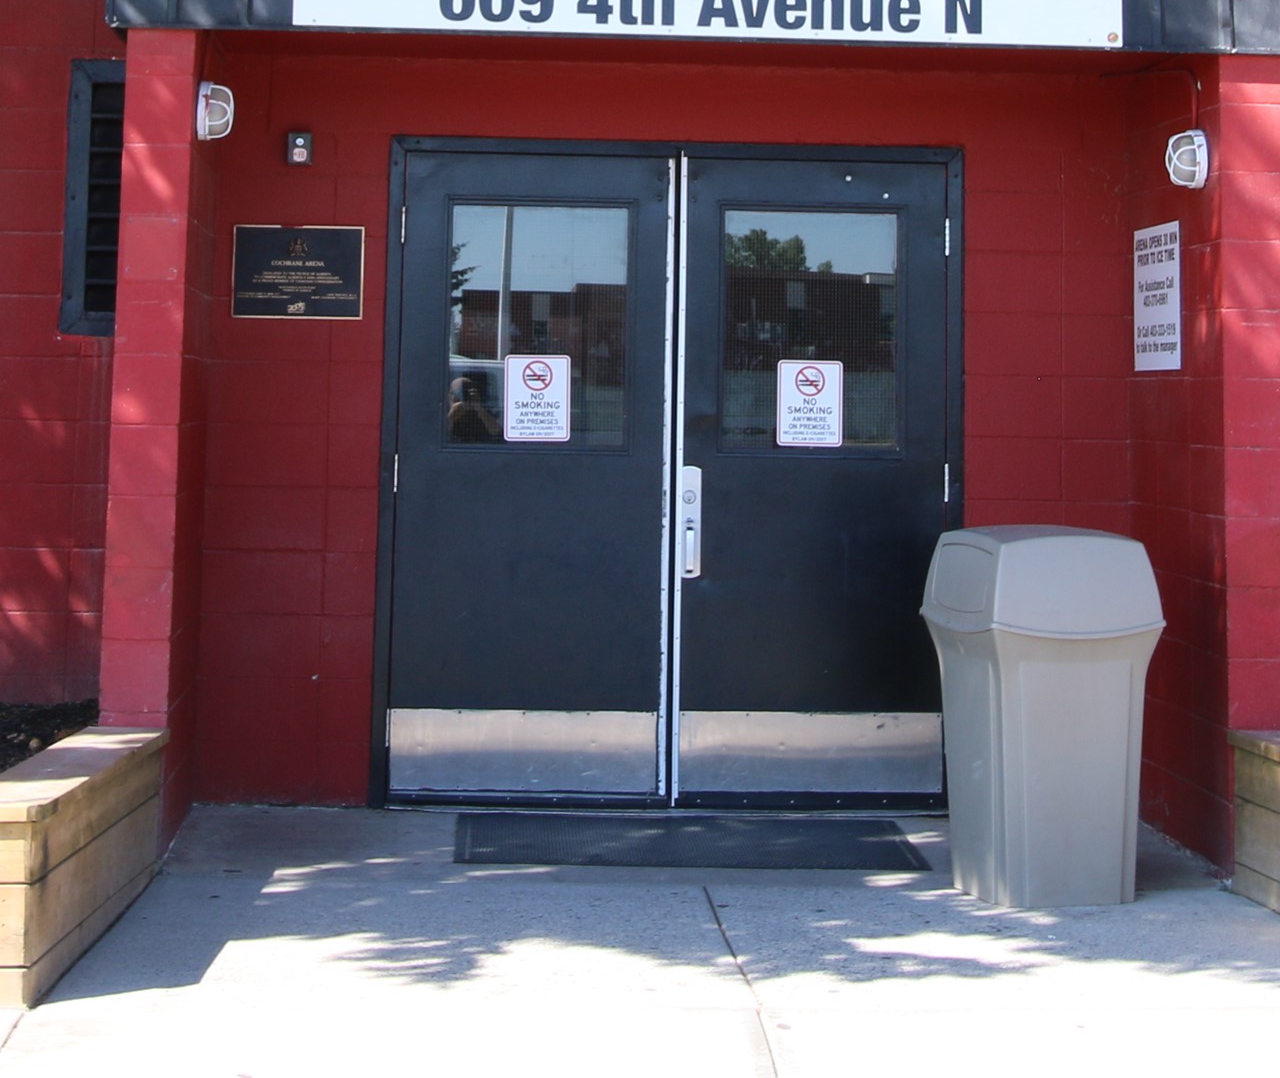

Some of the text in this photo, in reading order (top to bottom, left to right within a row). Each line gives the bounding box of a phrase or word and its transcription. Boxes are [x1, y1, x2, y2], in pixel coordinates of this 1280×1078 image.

[530, 392, 545, 400] NO
[514, 401, 560, 409] SMOKING
[787, 406, 833, 415] SMOKING
